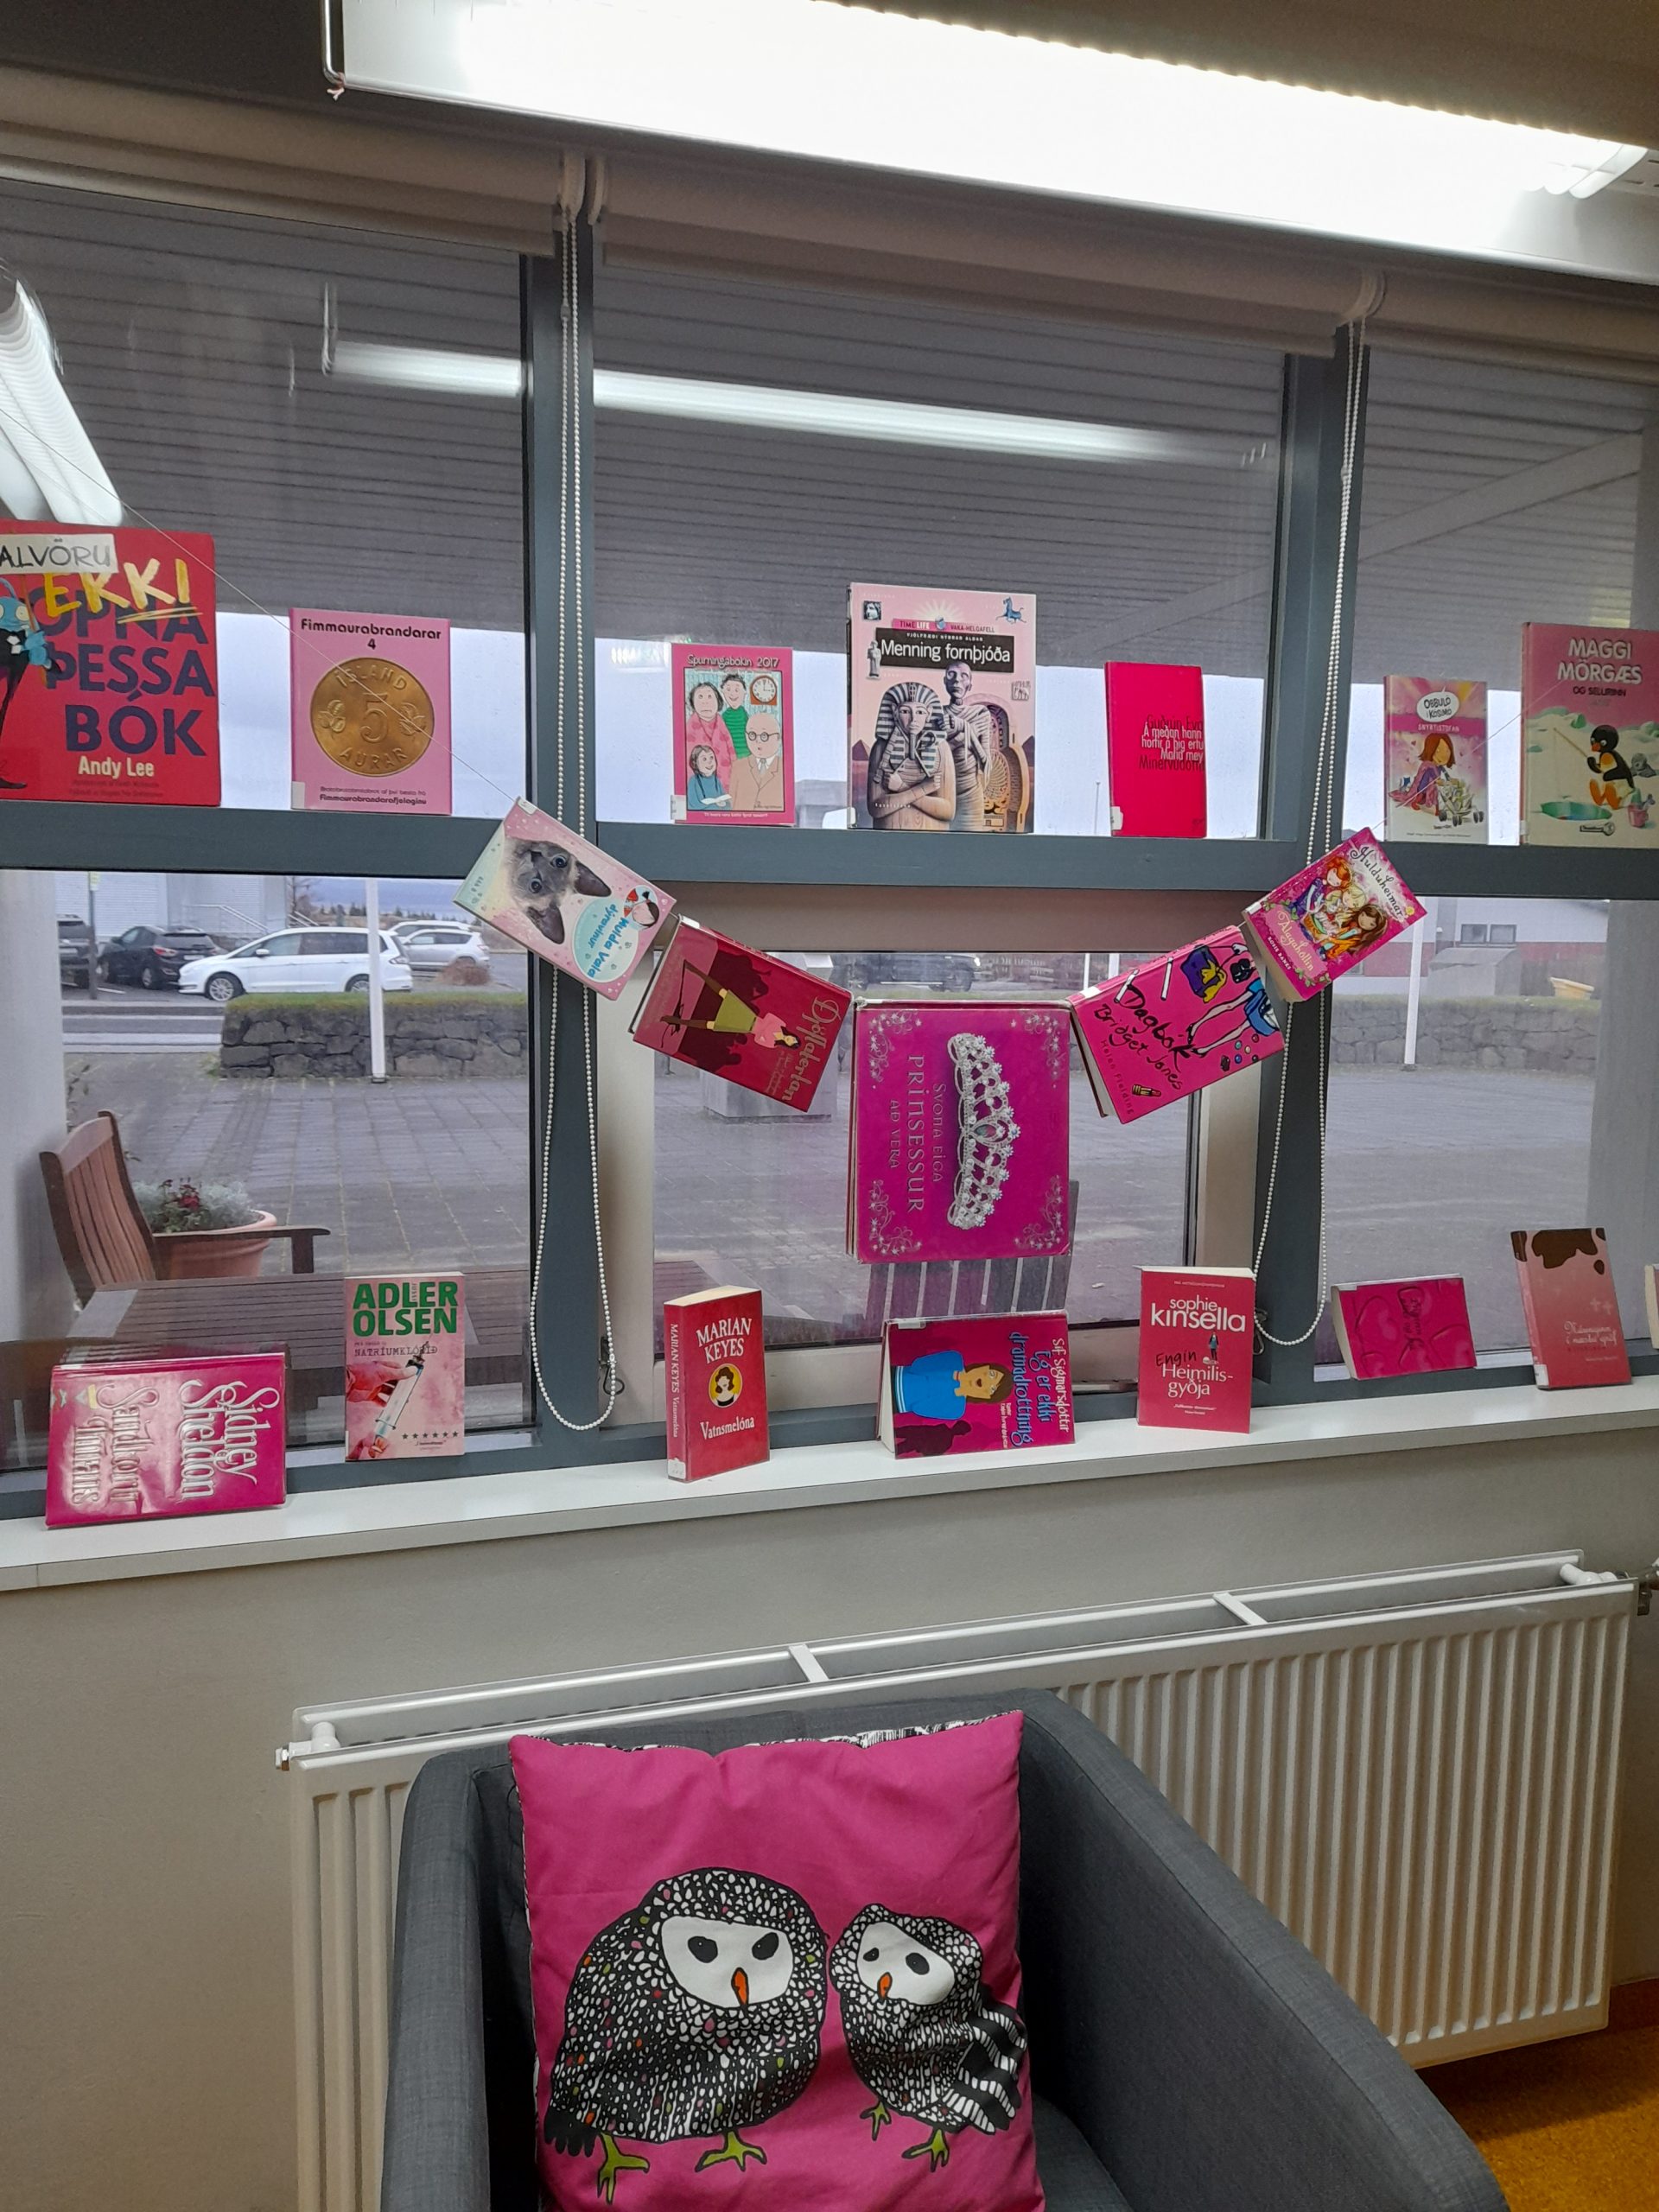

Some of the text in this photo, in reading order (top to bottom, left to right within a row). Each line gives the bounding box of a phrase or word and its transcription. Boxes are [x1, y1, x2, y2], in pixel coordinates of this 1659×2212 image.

[45, 558, 190, 618] EKKI
[29, 587, 208, 645] OPNA
[301, 618, 442, 639] Fimmaurabrandarar
[899, 620, 931, 630] TIME LIFE
[367, 638, 376, 650] 4
[881, 639, 1010, 664] Menning fornþjóða
[1568, 638, 1632, 660] MAGGI
[45, 641, 215, 697] ÞESSA
[757, 657, 780, 668] 2017
[1557, 658, 1642, 684] MÖRGÆS
[1573, 686, 1586, 695] OG
[65, 690, 207, 756] BÓK
[359, 691, 388, 744] 5
[1181, 726, 1202, 739] hann
[78, 755, 155, 779] Andy Lee
[1186, 752, 1203, 764] mey
[1350, 846, 1404, 917] Hulduheimar
[588, 953, 611, 978] Vala
[1094, 1002, 1182, 1090] Bridget Jones
[1100, 1039, 1135, 1116] Helen Fielding
[889, 1127, 900, 1169] VERA
[353, 1281, 459, 1310] ADLER
[1169, 1294, 1218, 1314] sophie
[353, 1307, 458, 1338] OLSEN
[1151, 1303, 1246, 1332] kinsella
[670, 1323, 679, 1363] MARIAN
[696, 1317, 753, 1347] MARIAN
[704, 1338, 745, 1364] KEYES
[1051, 1338, 1066, 1357] Sif
[1155, 1350, 1197, 1368] Engin
[671, 1363, 680, 1394] KEYES
[1035, 1375, 1052, 1391] er
[1162, 1363, 1234, 1382] Heimilis-
[1008, 1332, 1034, 1447] dramadrottning
[1037, 1394, 1057, 1422] ekki
[179, 1379, 237, 1503] Sheldon
[216, 1380, 280, 1486] Sidney
[700, 1415, 755, 1440] Vatnsmelóna
